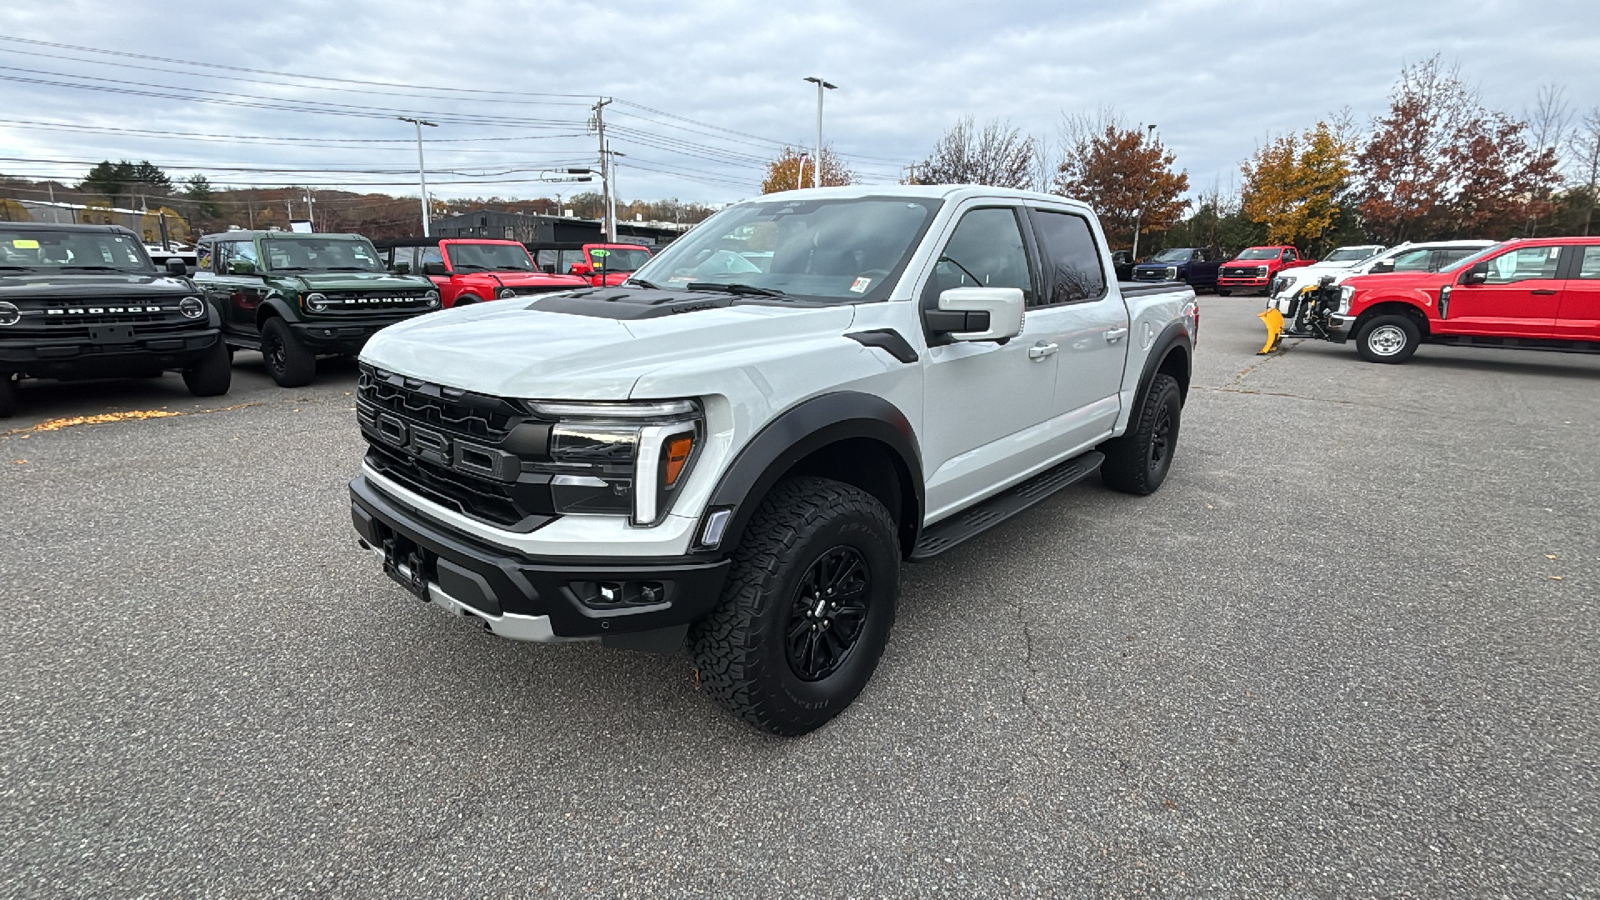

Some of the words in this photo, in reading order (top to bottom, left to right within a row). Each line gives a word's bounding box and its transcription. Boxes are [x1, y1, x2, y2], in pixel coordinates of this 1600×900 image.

[343, 296, 415, 305] BRONCO
[46, 305, 161, 315] BRONCO
[356, 399, 519, 484] FORD
